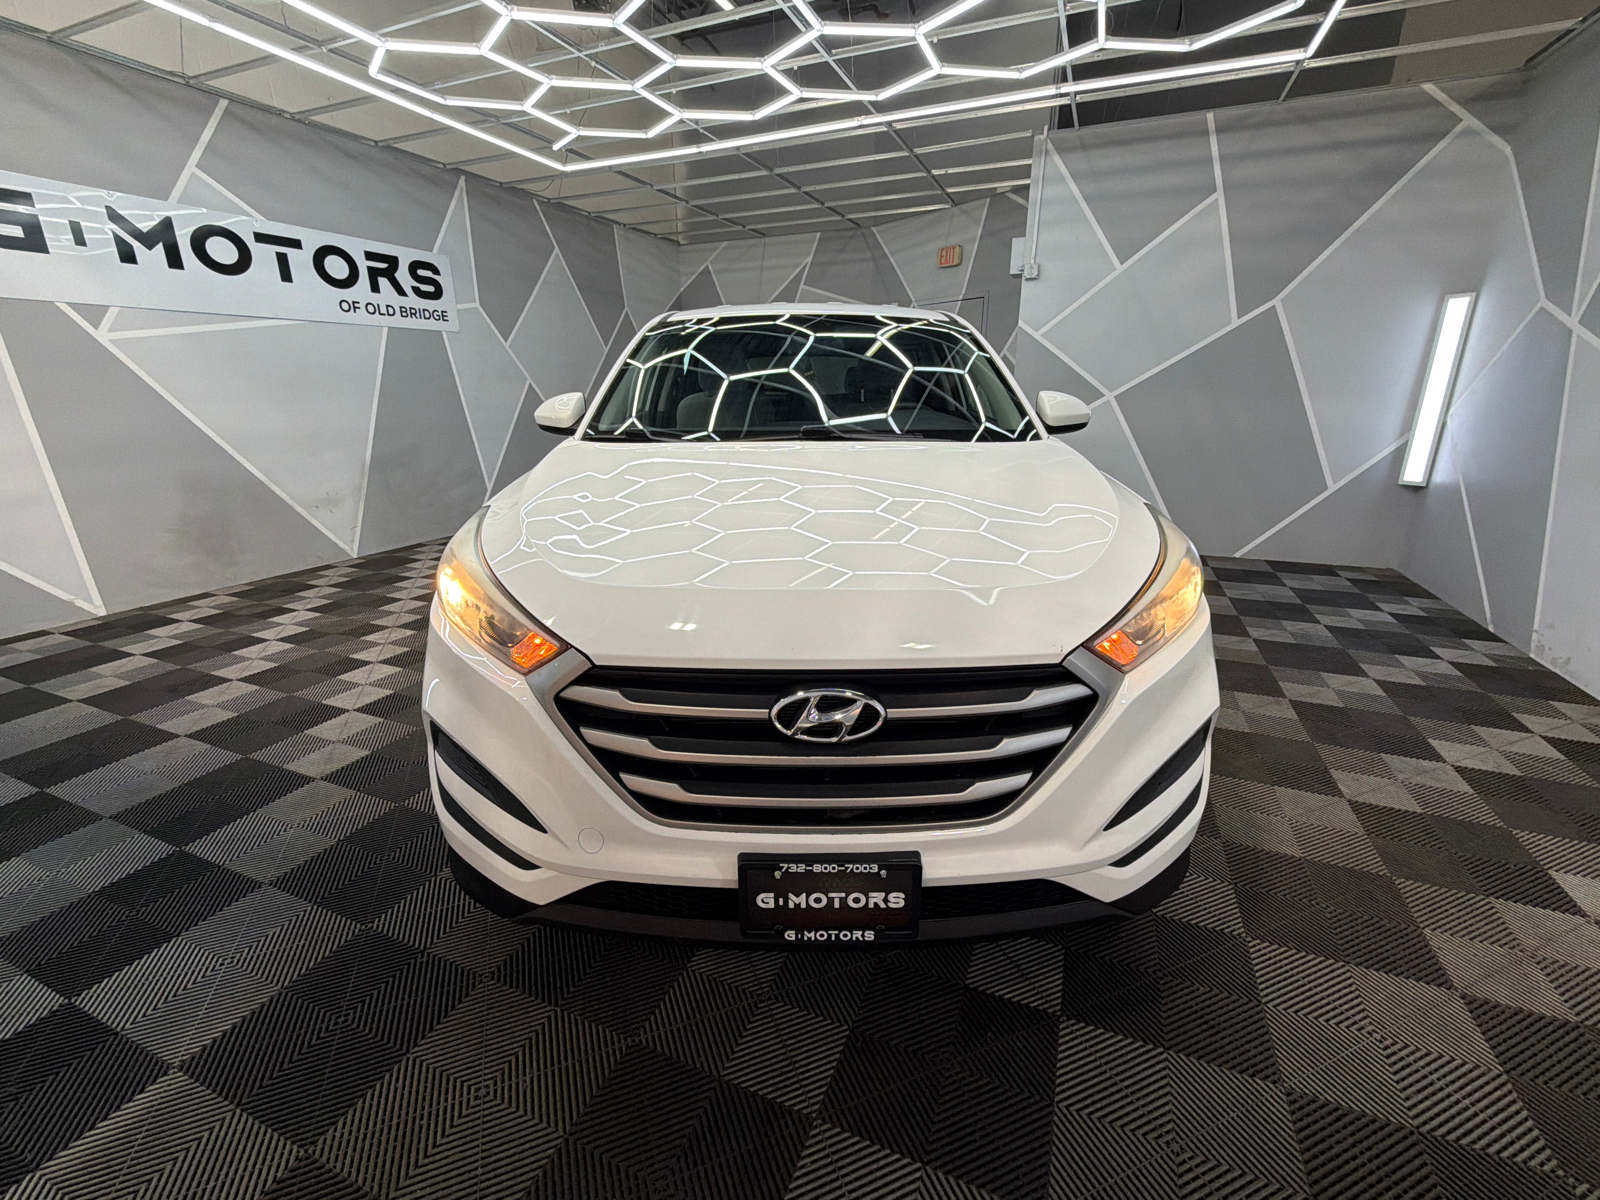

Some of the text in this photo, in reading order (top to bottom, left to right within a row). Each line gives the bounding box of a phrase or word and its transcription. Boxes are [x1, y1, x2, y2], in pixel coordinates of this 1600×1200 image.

[940, 246, 956, 265] EXIT
[339, 299, 449, 322] OF OLD BRIDGE
[779, 864, 878, 873] 732-800-7003
